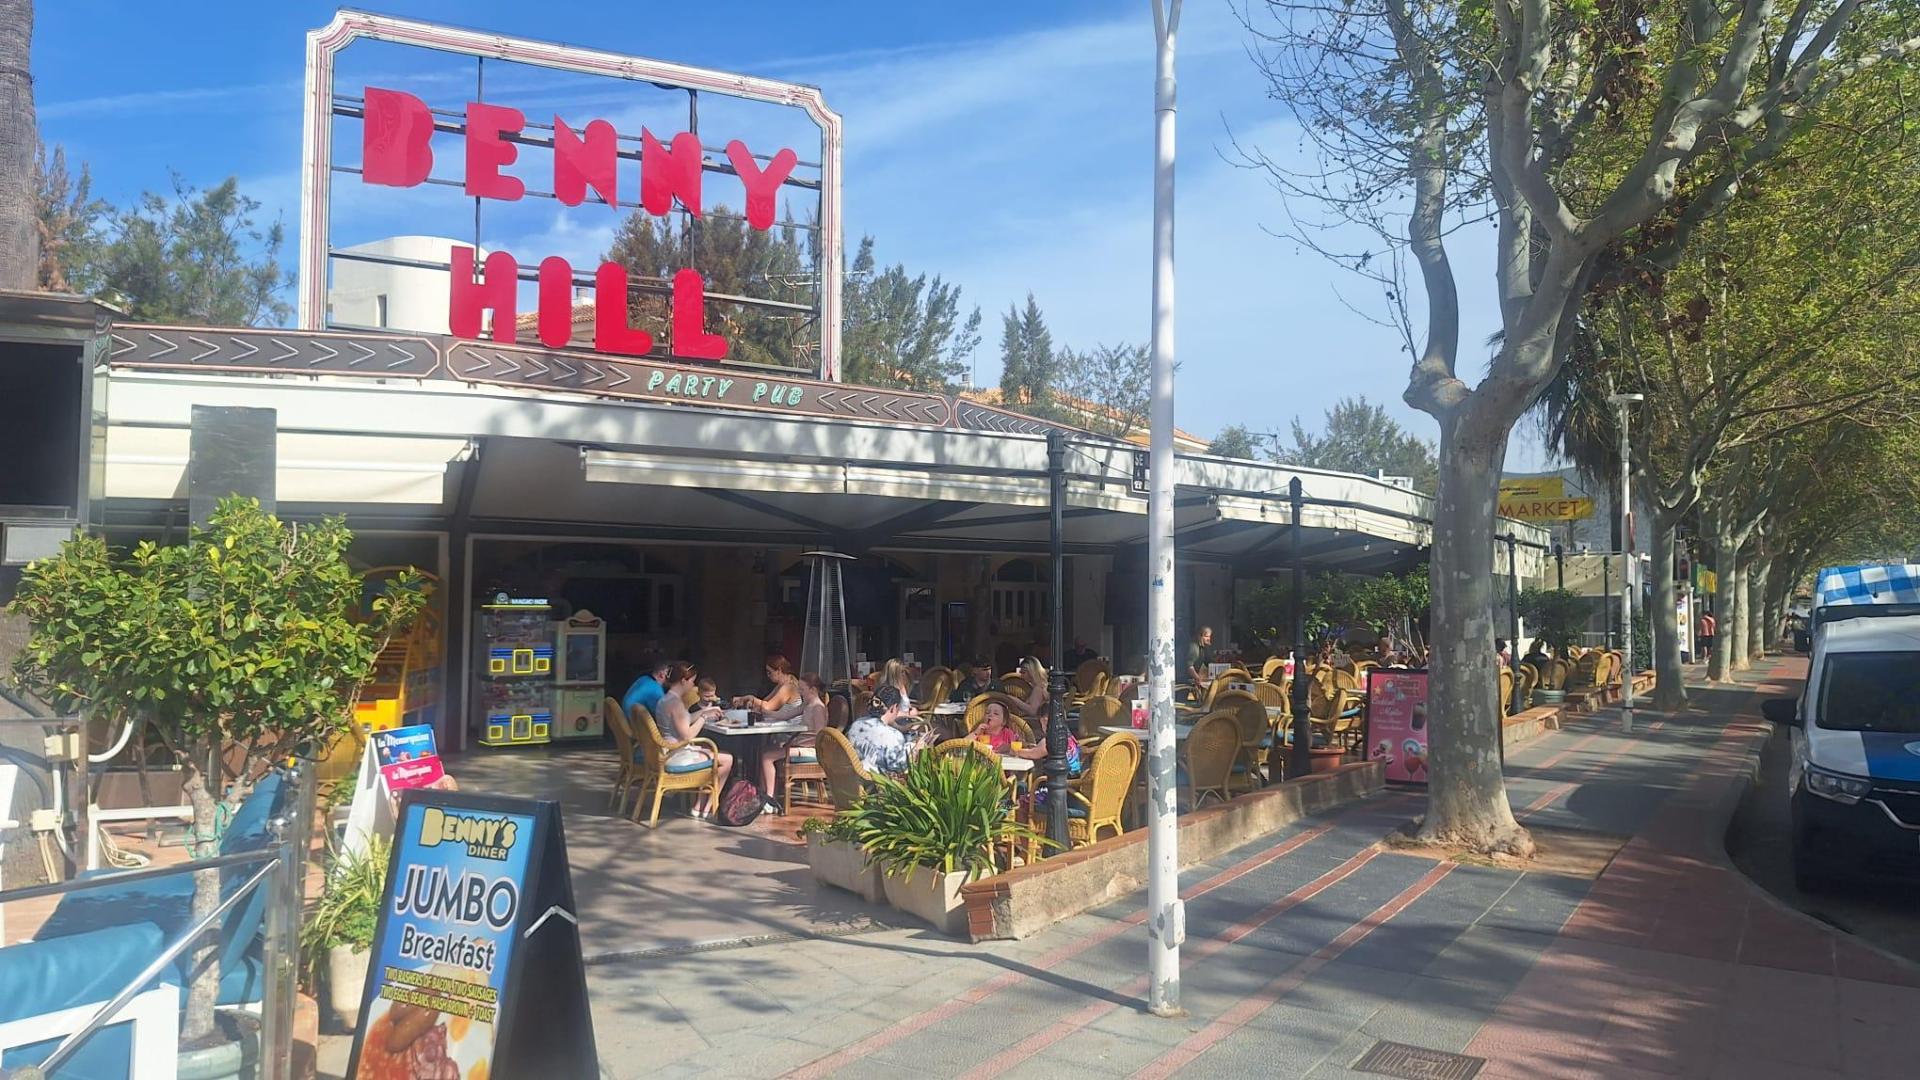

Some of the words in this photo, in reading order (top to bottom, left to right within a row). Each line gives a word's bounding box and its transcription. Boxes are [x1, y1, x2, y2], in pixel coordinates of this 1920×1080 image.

[362, 86, 798, 231] BENNY
[448, 245, 729, 360] HILL
[647, 370, 734, 398] PARTY
[753, 383, 804, 407] PUB
[1498, 501, 1579, 517] MARKET
[419, 806, 518, 848] BENNY'S
[468, 846, 508, 860] DINER
[396, 866, 518, 929] JUMBO
[400, 925, 496, 972] Breakfast
[382, 984, 393, 1000] TWO
[431, 994, 448, 1012] HASH
[448, 998, 469, 1017] BROWN
[475, 1004, 497, 1023] TOAST
[385, 966, 397, 981] TWO
[424, 974, 432, 988] OF
[455, 980, 467, 996] TWO
[467, 983, 497, 1004] SAUSAGES
